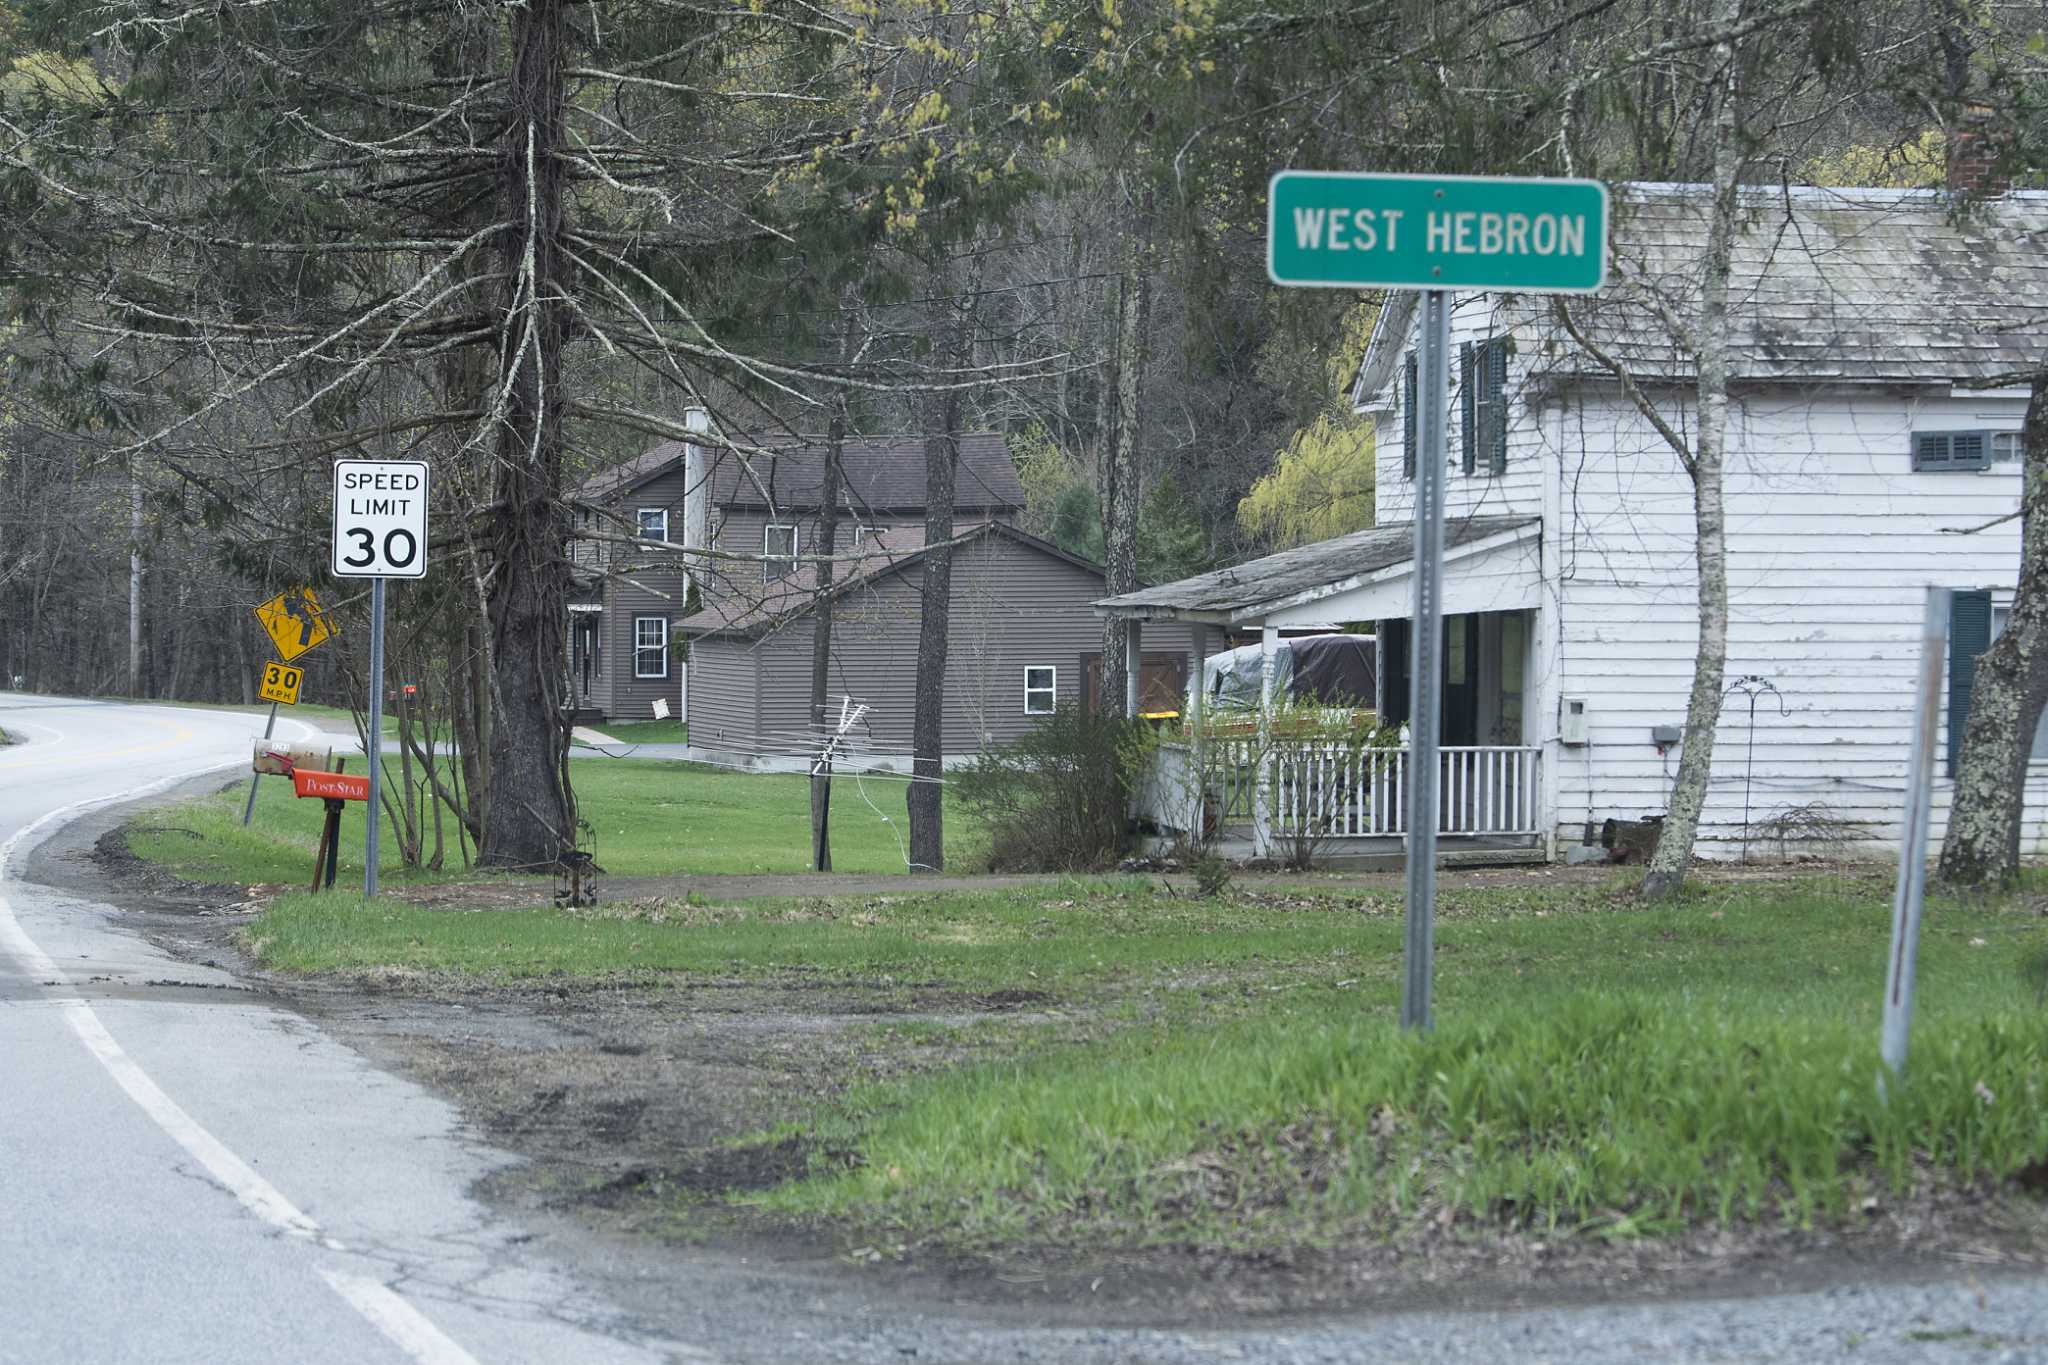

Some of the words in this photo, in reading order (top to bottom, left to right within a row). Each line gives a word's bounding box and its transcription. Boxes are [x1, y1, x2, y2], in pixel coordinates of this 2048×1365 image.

[1294, 207, 1404, 251] WEST
[1426, 211, 1585, 256] HEBRON
[344, 473, 419, 490] SPEED
[351, 498, 411, 516] LIMIT
[343, 527, 417, 569] 30
[267, 667, 297, 689] 30
